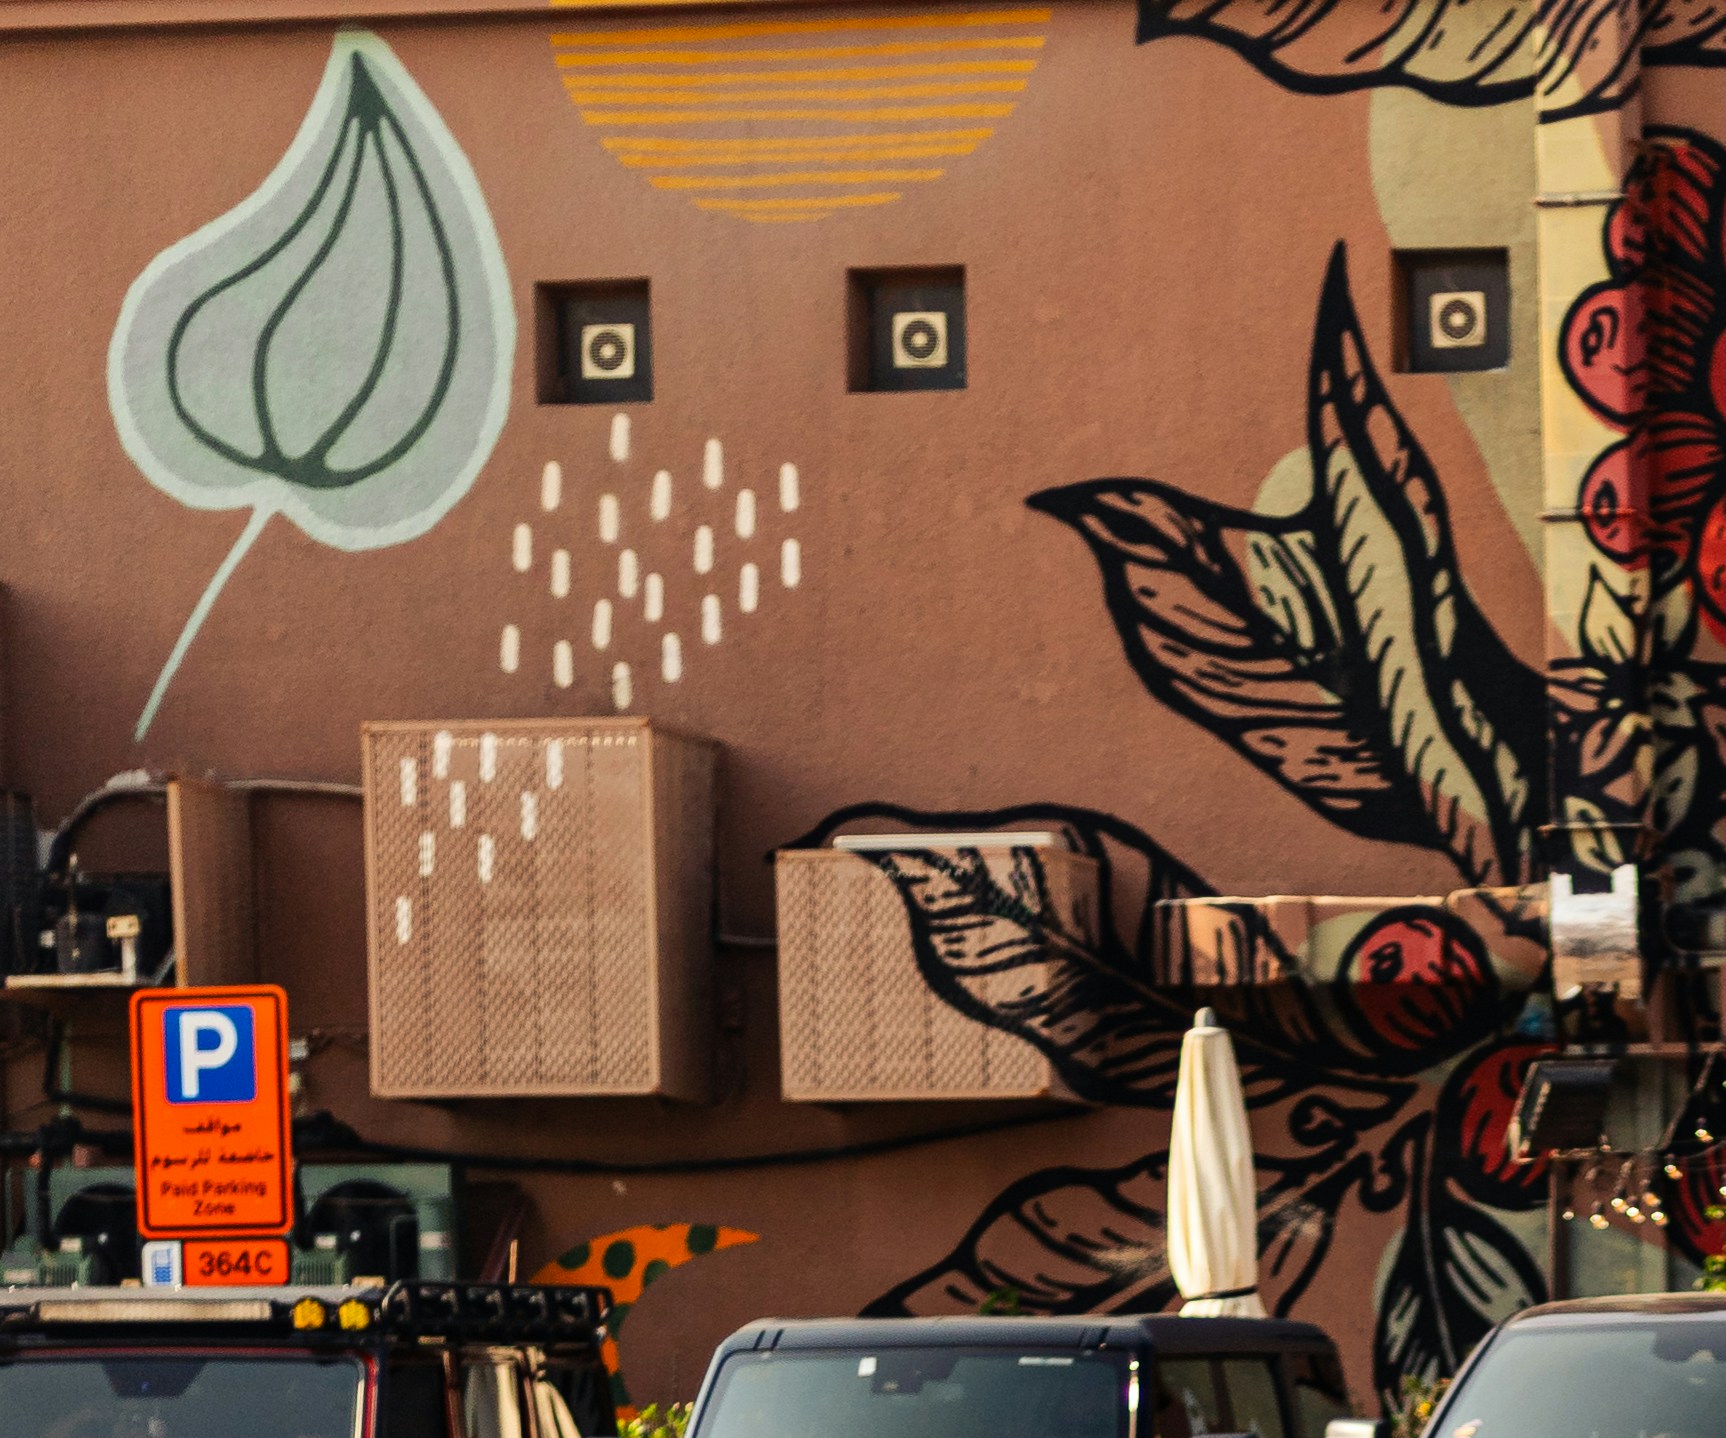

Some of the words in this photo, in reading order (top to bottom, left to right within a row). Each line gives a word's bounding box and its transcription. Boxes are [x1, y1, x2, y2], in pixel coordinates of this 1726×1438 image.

[178, 1010, 238, 1099] P
[160, 1180, 198, 1198] Paid
[201, 1177, 268, 1198] Parking
[193, 1200, 236, 1217] Zone
[199, 1250, 273, 1278] 364C
